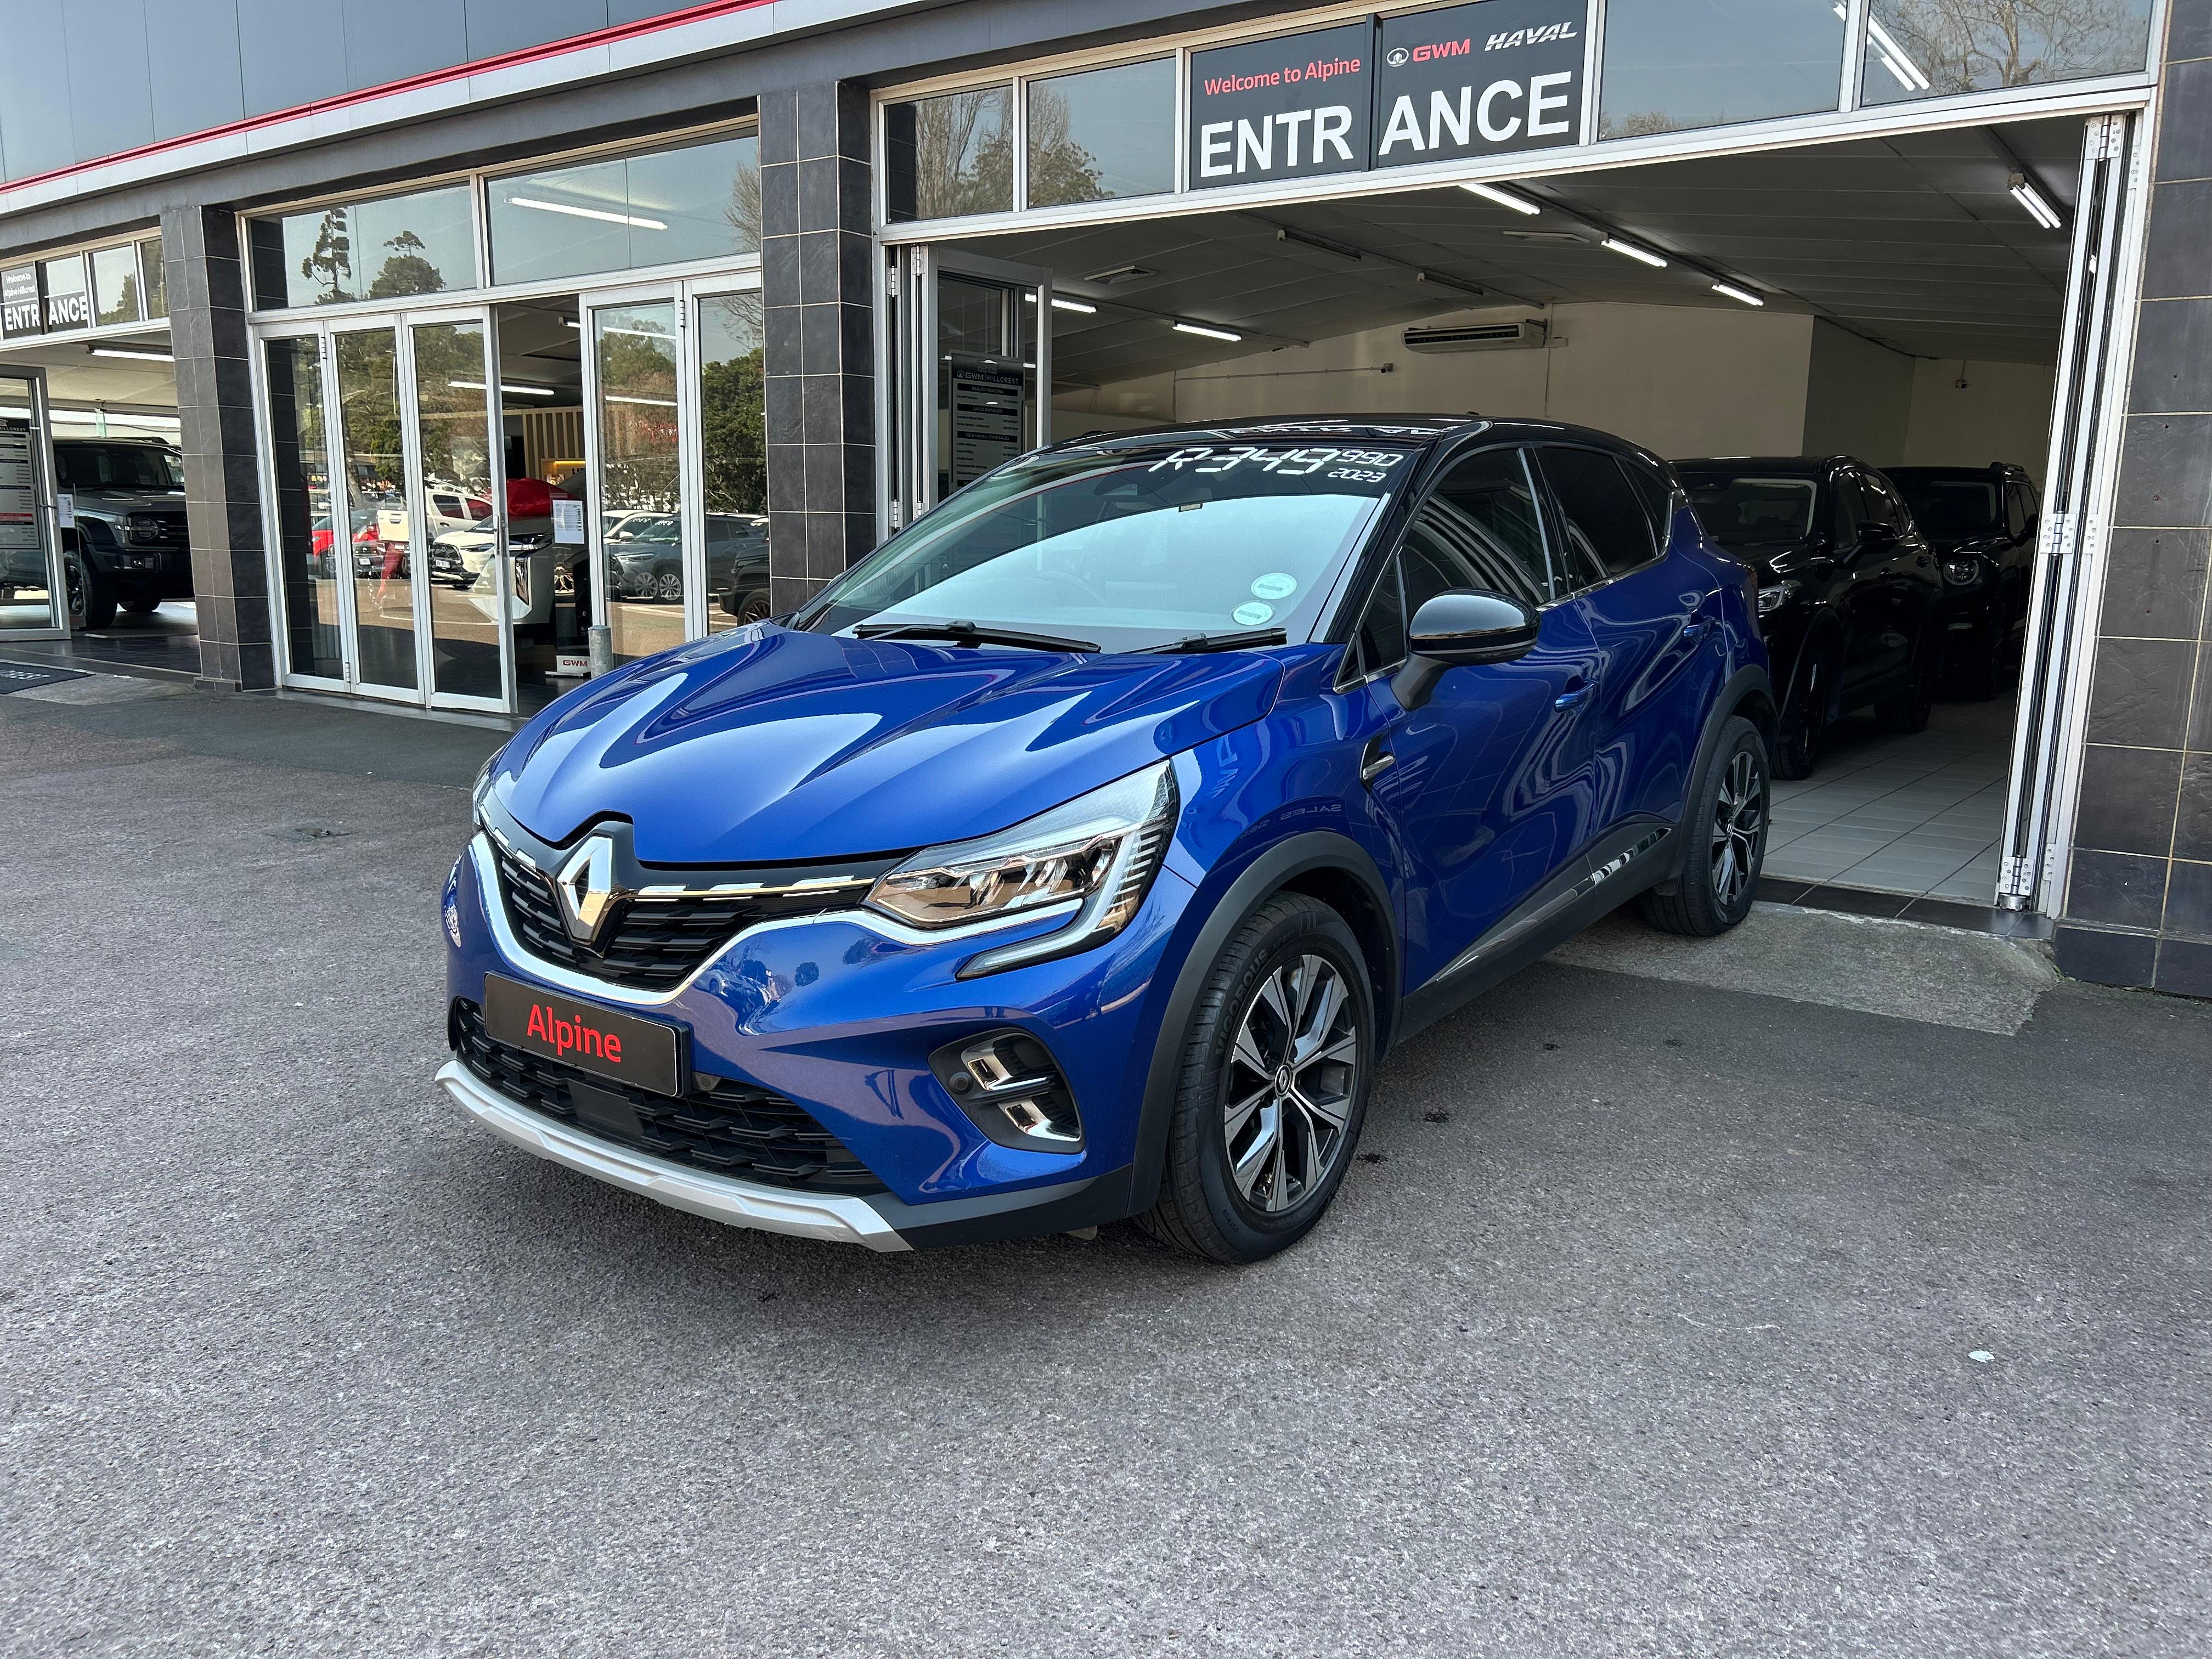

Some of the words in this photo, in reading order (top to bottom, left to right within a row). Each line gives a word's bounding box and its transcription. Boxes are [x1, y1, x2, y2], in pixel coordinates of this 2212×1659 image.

[1413, 38, 1471, 63] GWM
[1483, 21, 1578, 52] HAVAL
[1204, 75, 1280, 95] Welcome
[1283, 67, 1301, 83] to
[1305, 58, 1361, 82] Alpine
[988, 376, 1019, 384] HILLCREST
[1327, 468, 1386, 482] 2023
[527, 1003, 622, 1063] Alpine
